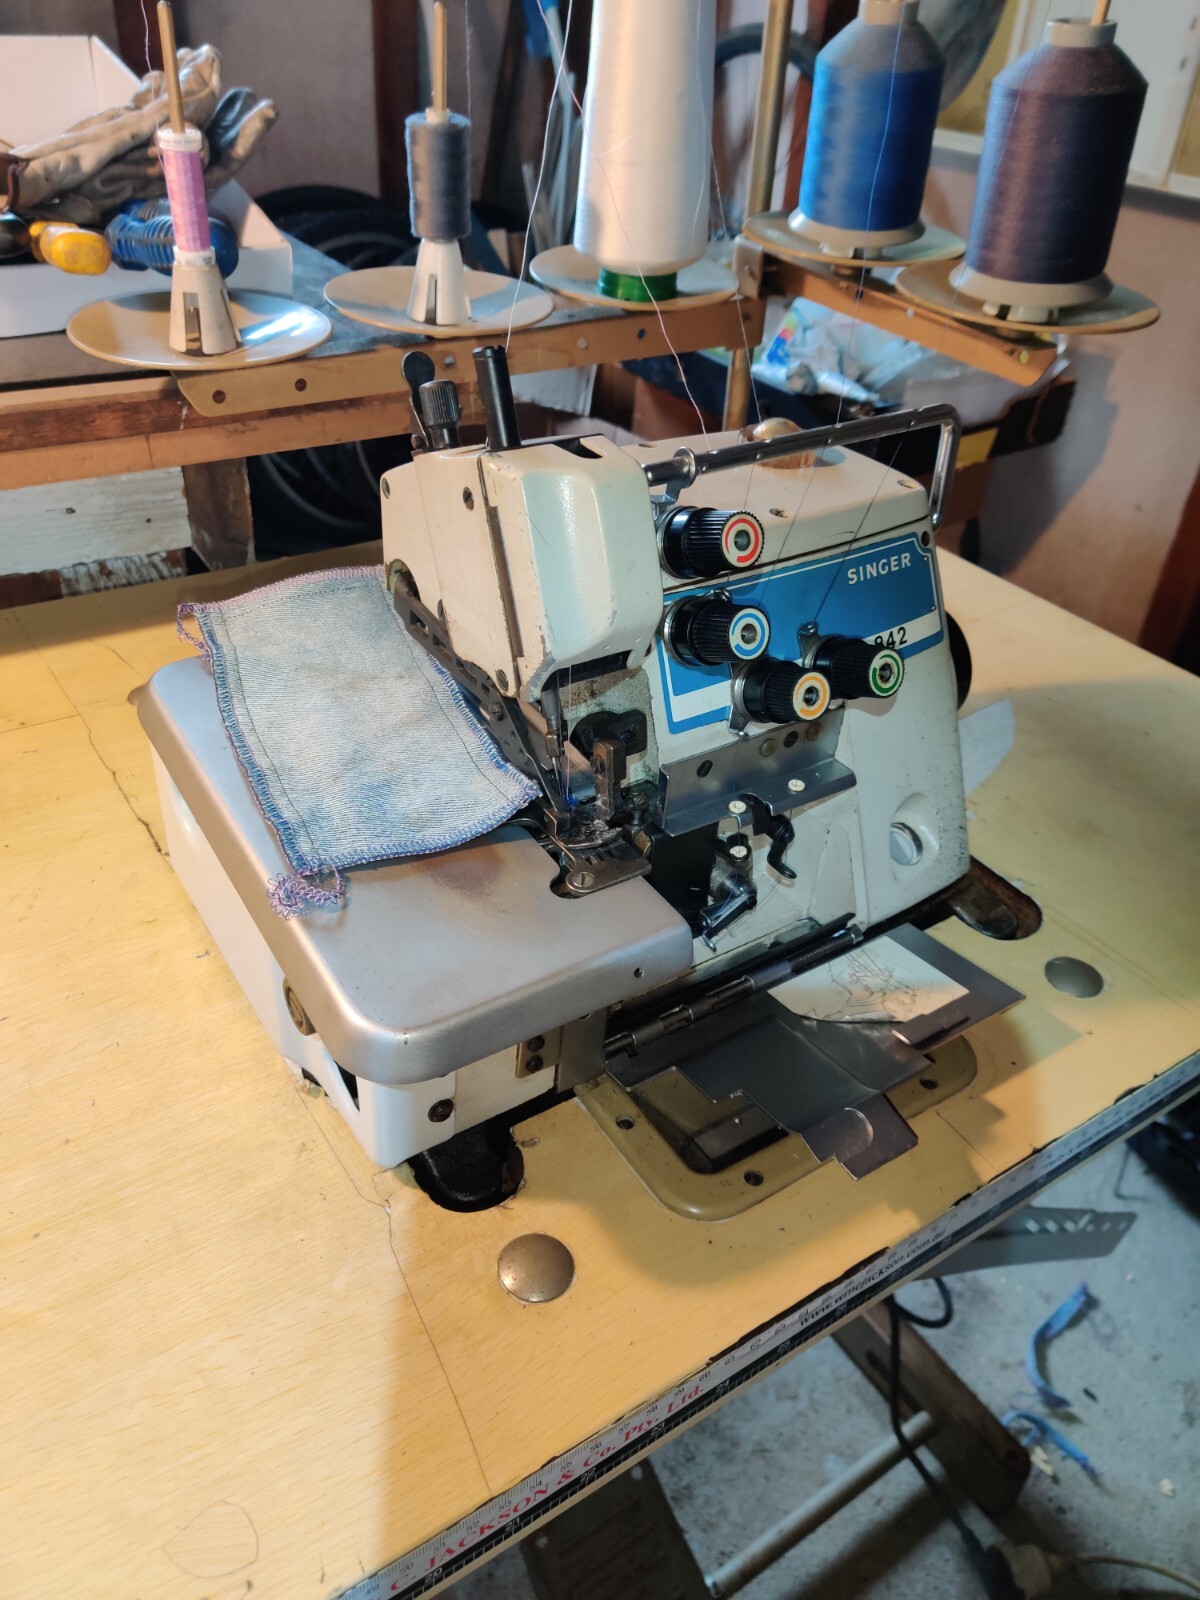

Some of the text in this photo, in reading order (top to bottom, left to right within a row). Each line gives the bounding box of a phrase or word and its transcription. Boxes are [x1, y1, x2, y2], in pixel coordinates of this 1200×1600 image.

[847, 552, 911, 585] SINGER
[390, 1385, 704, 1591] C. JACKSON & Co. Pty. Ltd.
[400, 1562, 414, 1575] 50
[433, 1541, 446, 1553] 51
[466, 1520, 480, 1533] 52
[498, 1500, 512, 1512] 53
[529, 1480, 542, 1492] 54
[560, 1461, 573, 1473] 55
[589, 1441, 602, 1453] 56
[618, 1422, 631, 1435] 57
[646, 1404, 658, 1416] 58
[672, 1387, 685, 1399] 59
[699, 1370, 711, 1382] 60
[724, 1355, 735, 1366] 61
[750, 1338, 762, 1351] 62
[798, 1308, 809, 1321] 64
